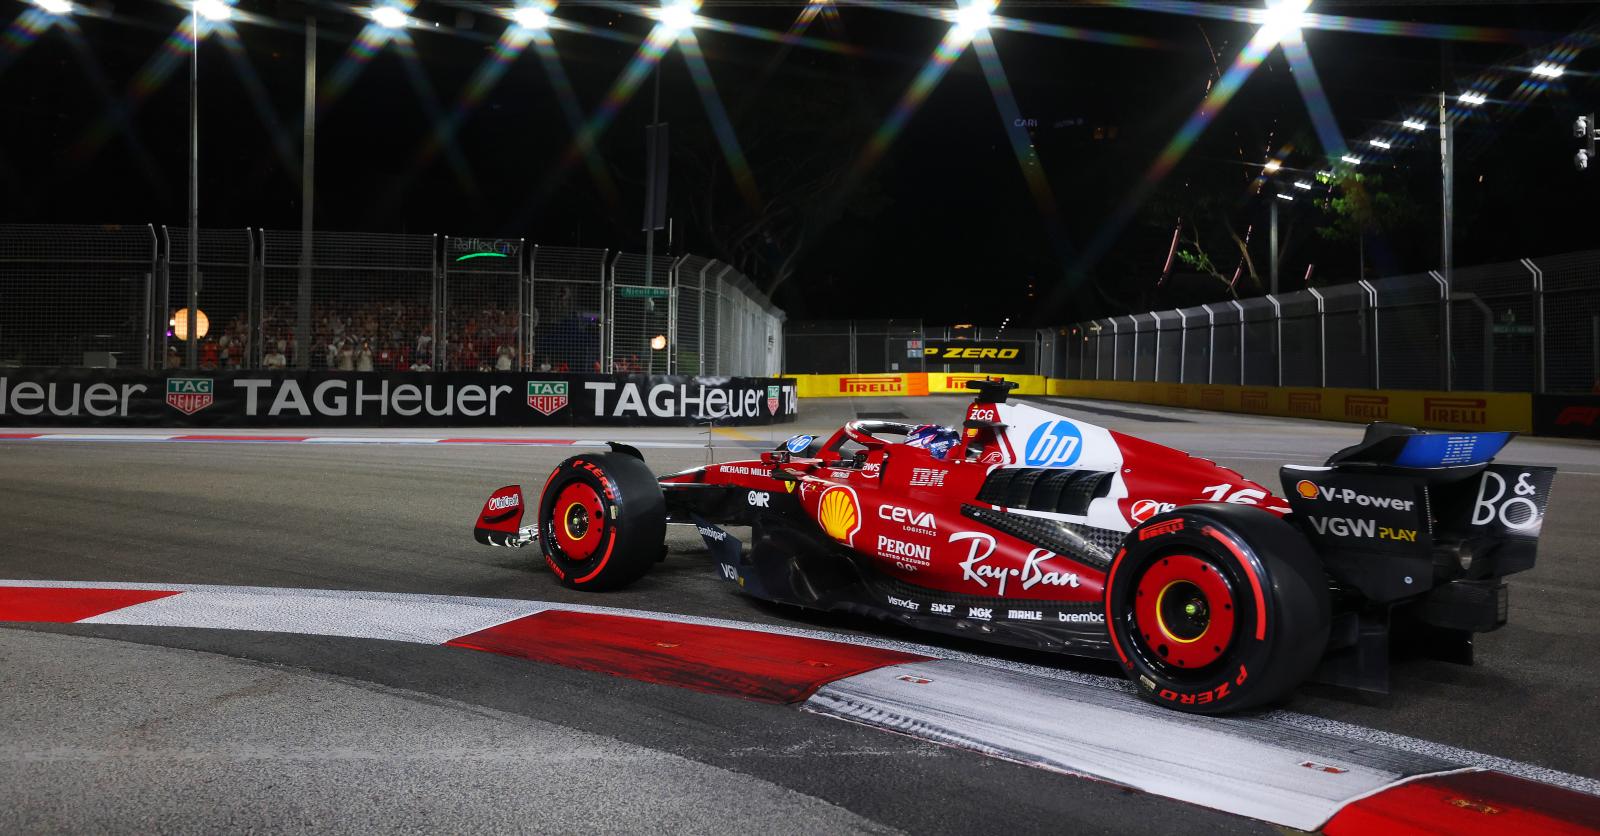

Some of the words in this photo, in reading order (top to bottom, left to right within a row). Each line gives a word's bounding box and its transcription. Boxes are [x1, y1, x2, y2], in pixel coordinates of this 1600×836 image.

[943, 347, 1019, 359] ZERO
[170, 380, 209, 393] TAG
[530, 383, 565, 395] TAG
[840, 377, 902, 393] PIRELLI
[0, 377, 147, 417] euer
[168, 394, 211, 412] HEUER
[529, 396, 566, 413] HEUER
[970, 409, 994, 421] ZCG
[1424, 397, 1488, 425] PIRELLI
[1027, 419, 1081, 467] hp
[720, 465, 749, 475] RICHARD
[750, 467, 773, 478] MILLE
[862, 463, 880, 472] aws
[909, 467, 949, 487] IBM
[1201, 483, 1267, 505] 16
[1319, 485, 1414, 512] V-Power
[902, 525, 937, 537] LOGISTICS
[1308, 515, 1376, 538] VGW
[1379, 527, 1417, 542] PLAY
[877, 535, 932, 560] PERONI
[877, 551, 901, 560] NASTRO
[931, 603, 955, 613] SKF
[968, 608, 993, 620] NGK
[1008, 609, 1043, 620] MAHLE
[1159, 681, 1230, 705] ZERO
